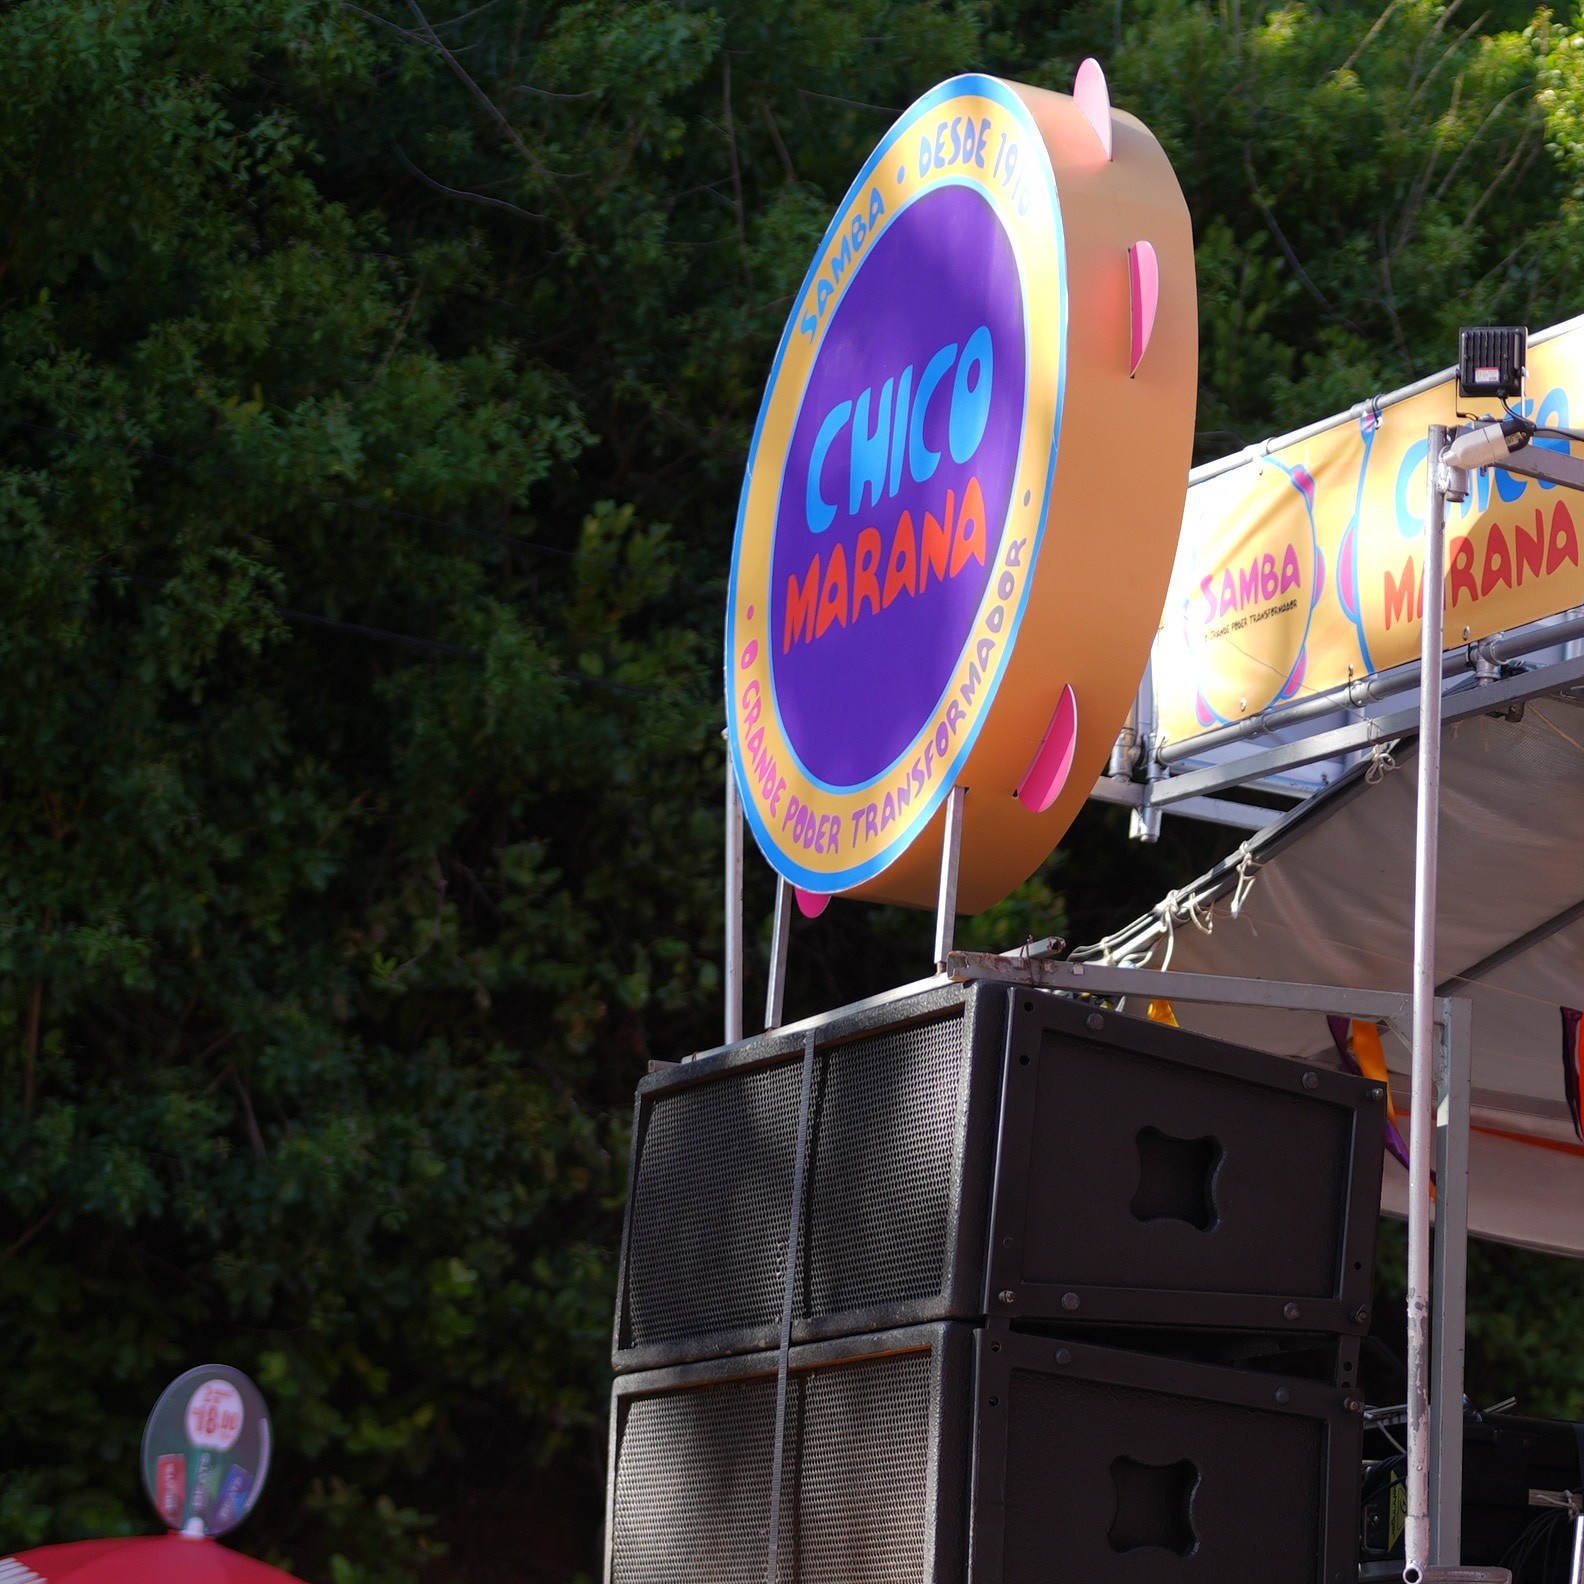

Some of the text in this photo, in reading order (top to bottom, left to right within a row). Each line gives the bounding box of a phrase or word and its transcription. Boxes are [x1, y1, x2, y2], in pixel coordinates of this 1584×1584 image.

[800, 186, 884, 345] SAMBA
[918, 115, 992, 177] DESDE
[804, 325, 994, 534] CHICO
[783, 475, 987, 655] MARANA
[1200, 543, 1300, 625] SAMBA
[740, 534, 1027, 856] O GRANDE PODER TRANSFORMADOR
